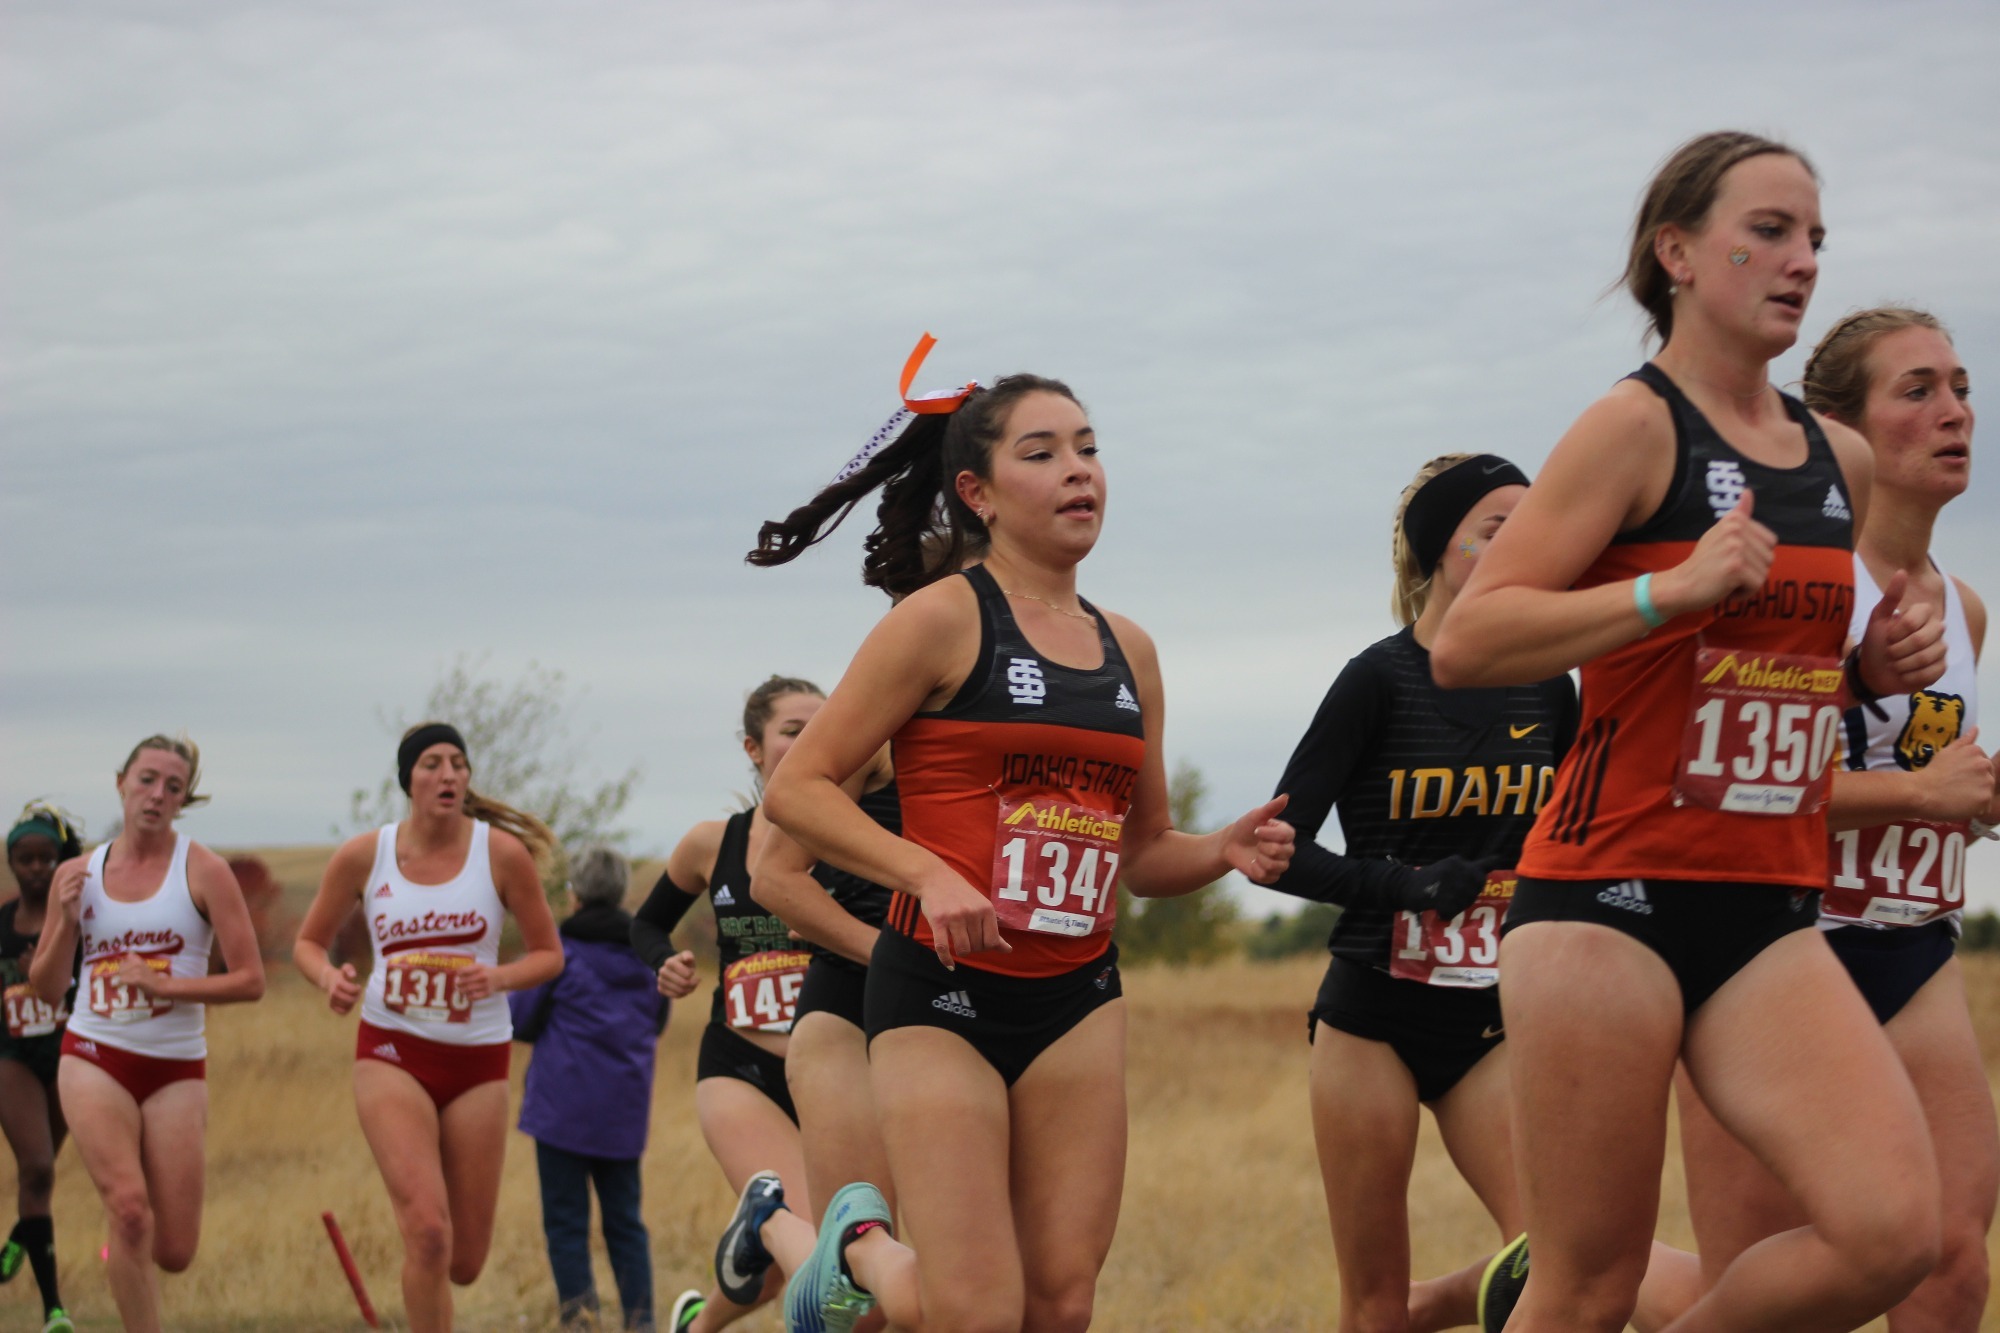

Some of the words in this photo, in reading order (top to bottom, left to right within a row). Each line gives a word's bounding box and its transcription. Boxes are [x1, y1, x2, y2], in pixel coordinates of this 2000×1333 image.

[1700, 654, 1814, 690] Athletic
[1686, 698, 1841, 783] 1350
[1001, 753, 1079, 789] IDAHO
[1003, 802, 1103, 837] Athletic
[998, 837, 1119, 914] 1347
[1833, 824, 1966, 903] 1420
[84, 928, 173, 956] Eastern
[374, 909, 479, 942] Eastern
[1398, 906, 1507, 965] 133
[728, 972, 804, 1028] 145
[931, 999, 977, 1019] adidas
